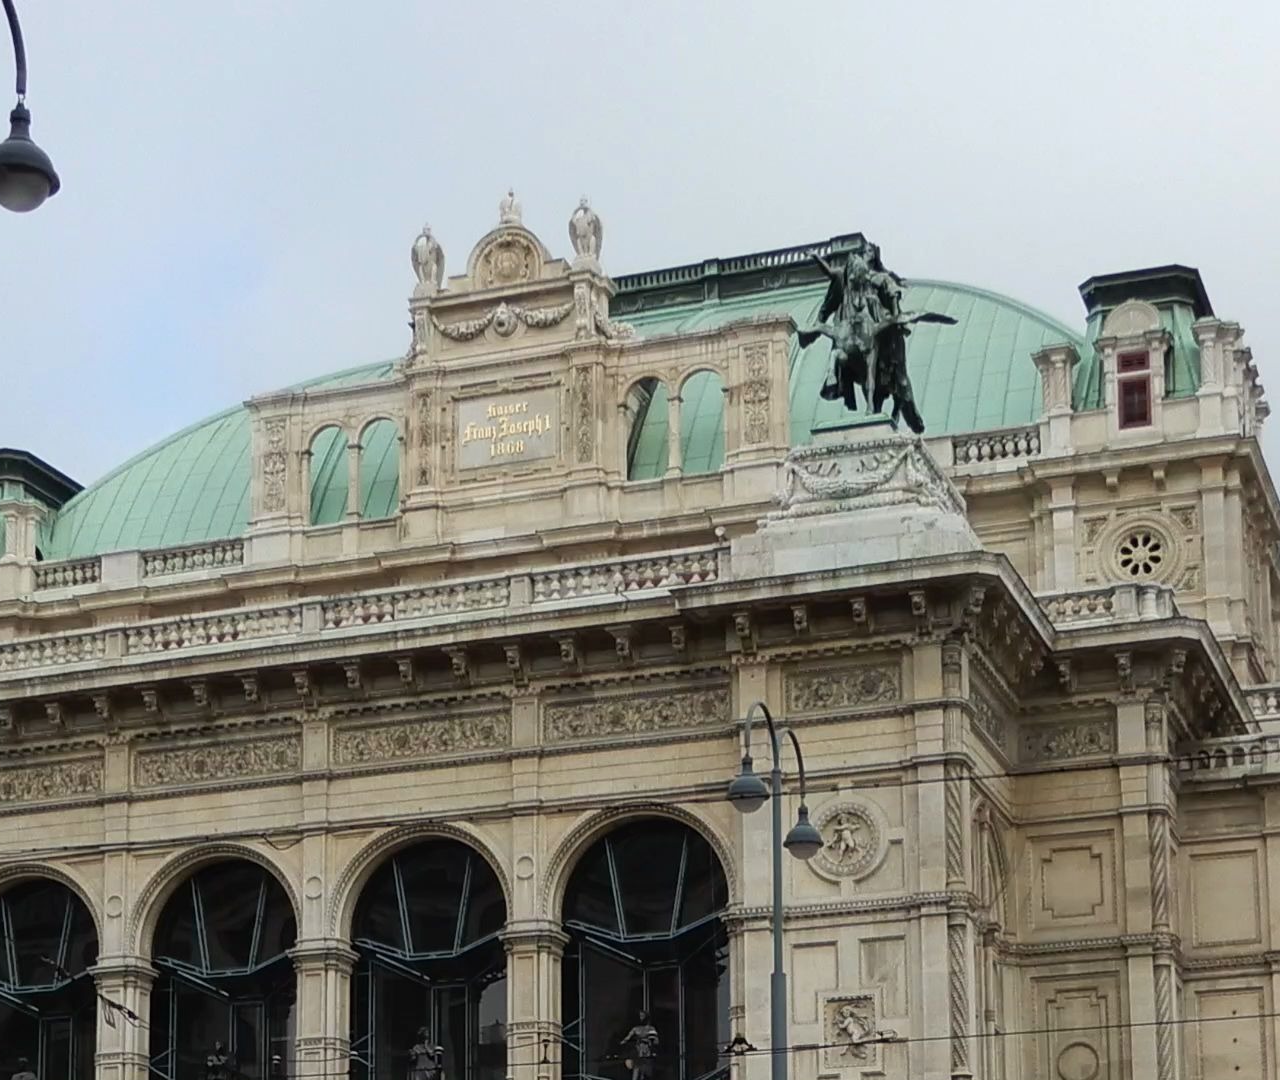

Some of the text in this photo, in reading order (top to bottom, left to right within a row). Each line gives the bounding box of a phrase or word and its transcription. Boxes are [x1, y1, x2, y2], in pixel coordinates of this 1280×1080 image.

[461, 422, 497, 445] Franz
[498, 413, 542, 438] Joseph
[490, 439, 524, 458] 1868
